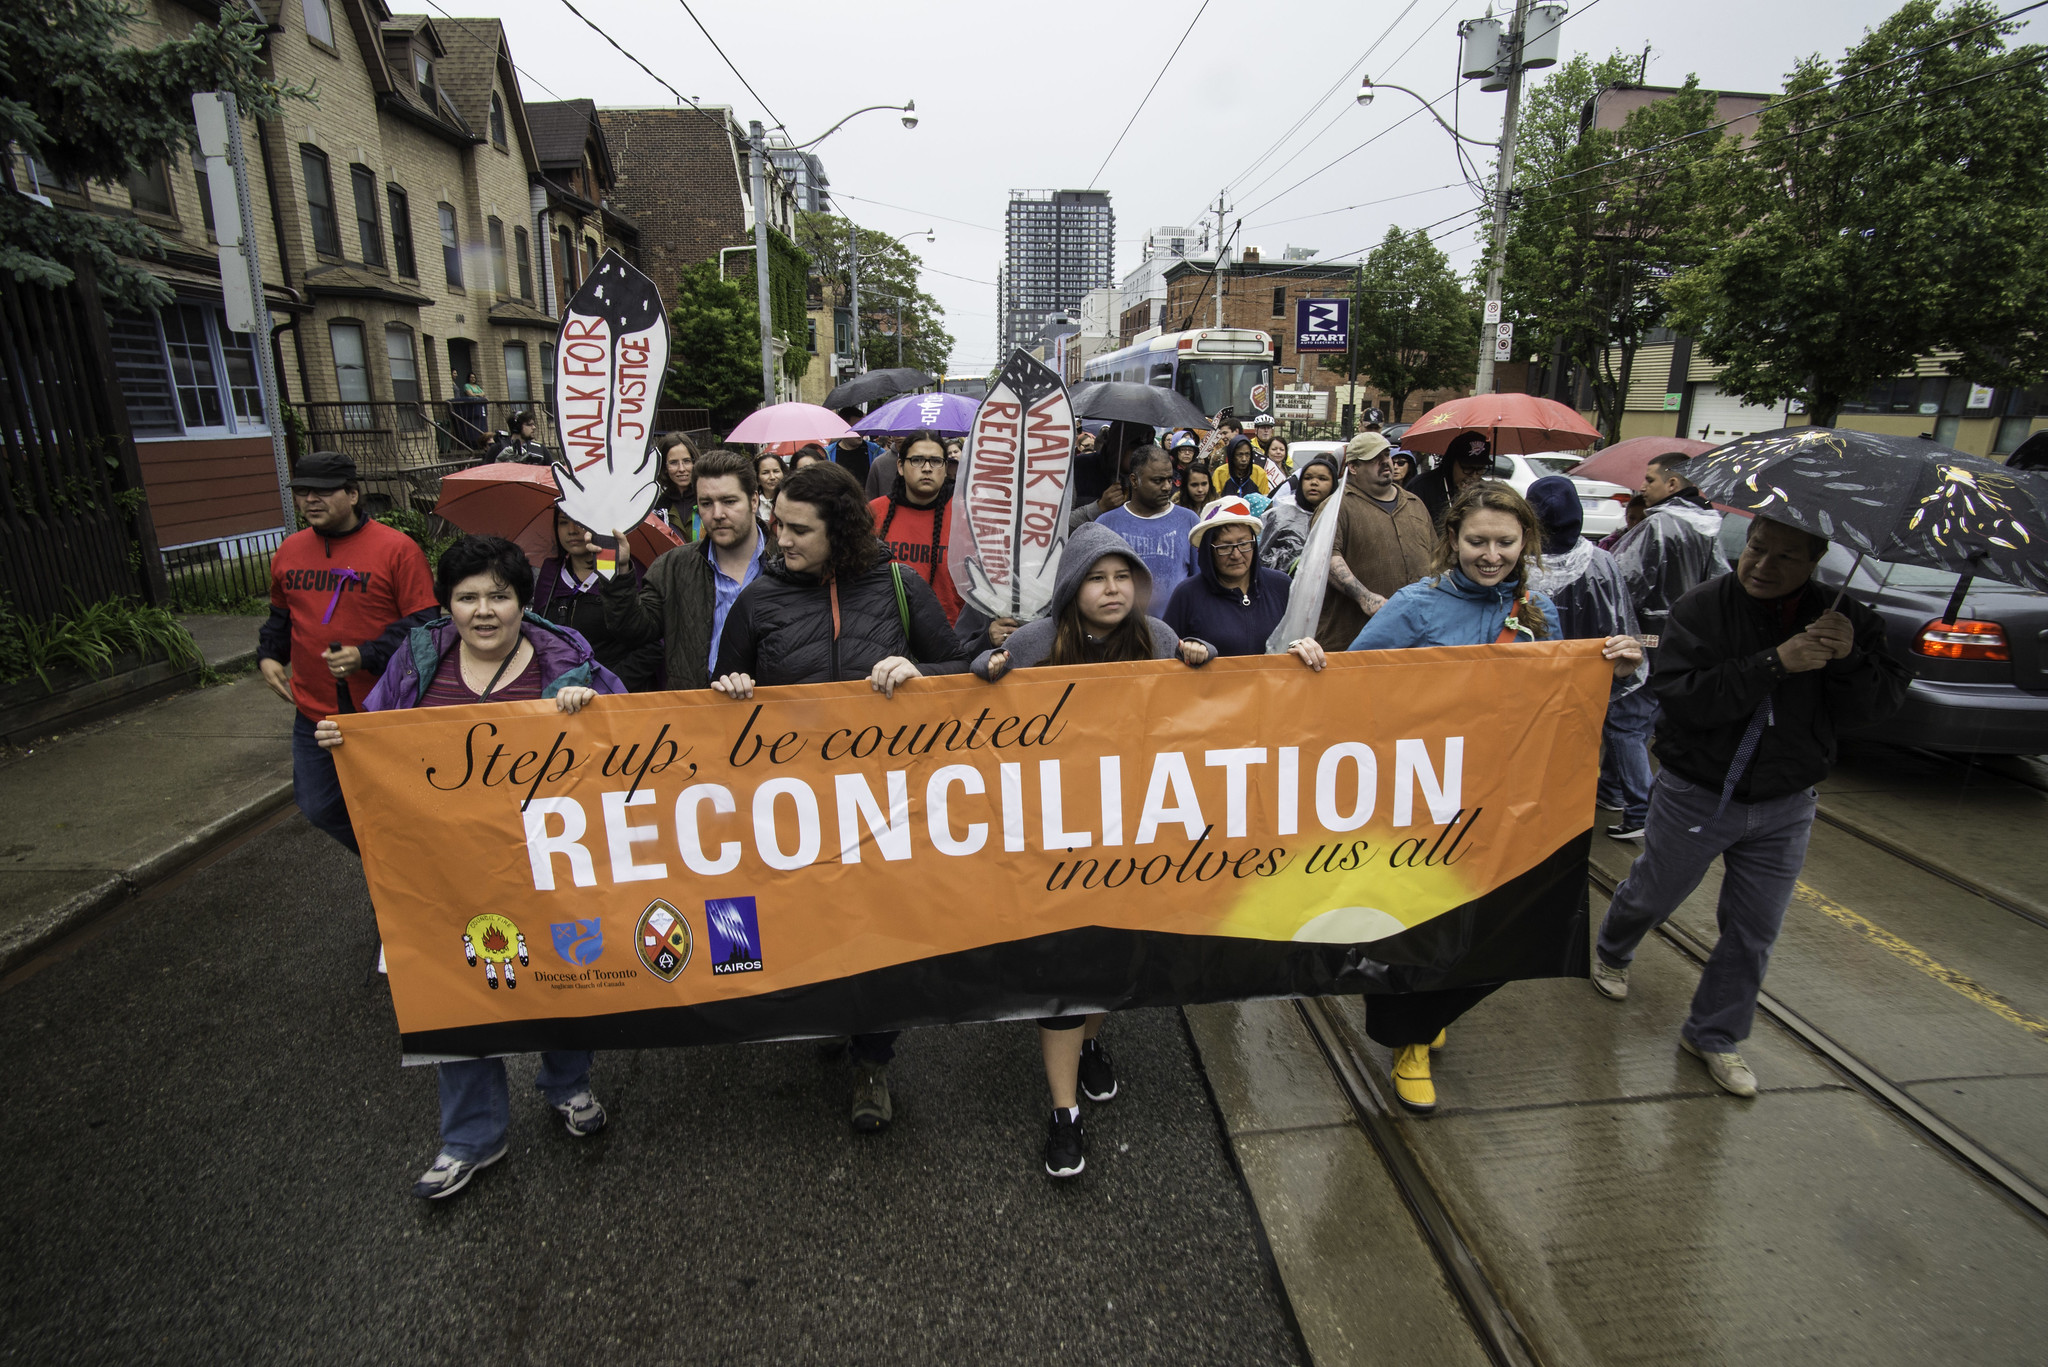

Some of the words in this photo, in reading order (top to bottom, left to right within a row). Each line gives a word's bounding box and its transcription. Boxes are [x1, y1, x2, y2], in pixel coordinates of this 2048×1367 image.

[563, 317, 606, 377] FOR
[618, 337, 650, 440] JUSTICE
[566, 385, 606, 472] WALK
[1026, 394, 1070, 489] WALK
[970, 401, 1021, 586] RECONCILIATION
[1264, 460, 1285, 487] WAL
[886, 541, 949, 564] ECURT
[1022, 500, 1059, 548] FOR
[426, 722, 590, 812] Step
[601, 724, 698, 803] up,
[729, 704, 809, 768] be
[821, 683, 1075, 761] counted
[521, 736, 1464, 891] RECONCILIATION
[1046, 824, 1297, 891] involves
[1305, 840, 1380, 874] us
[1389, 807, 1483, 868] all
[534, 971, 577, 982] Diocese
[580, 969, 591, 981] of
[593, 969, 637, 980] Toronto
[715, 961, 762, 973] KAIROS
